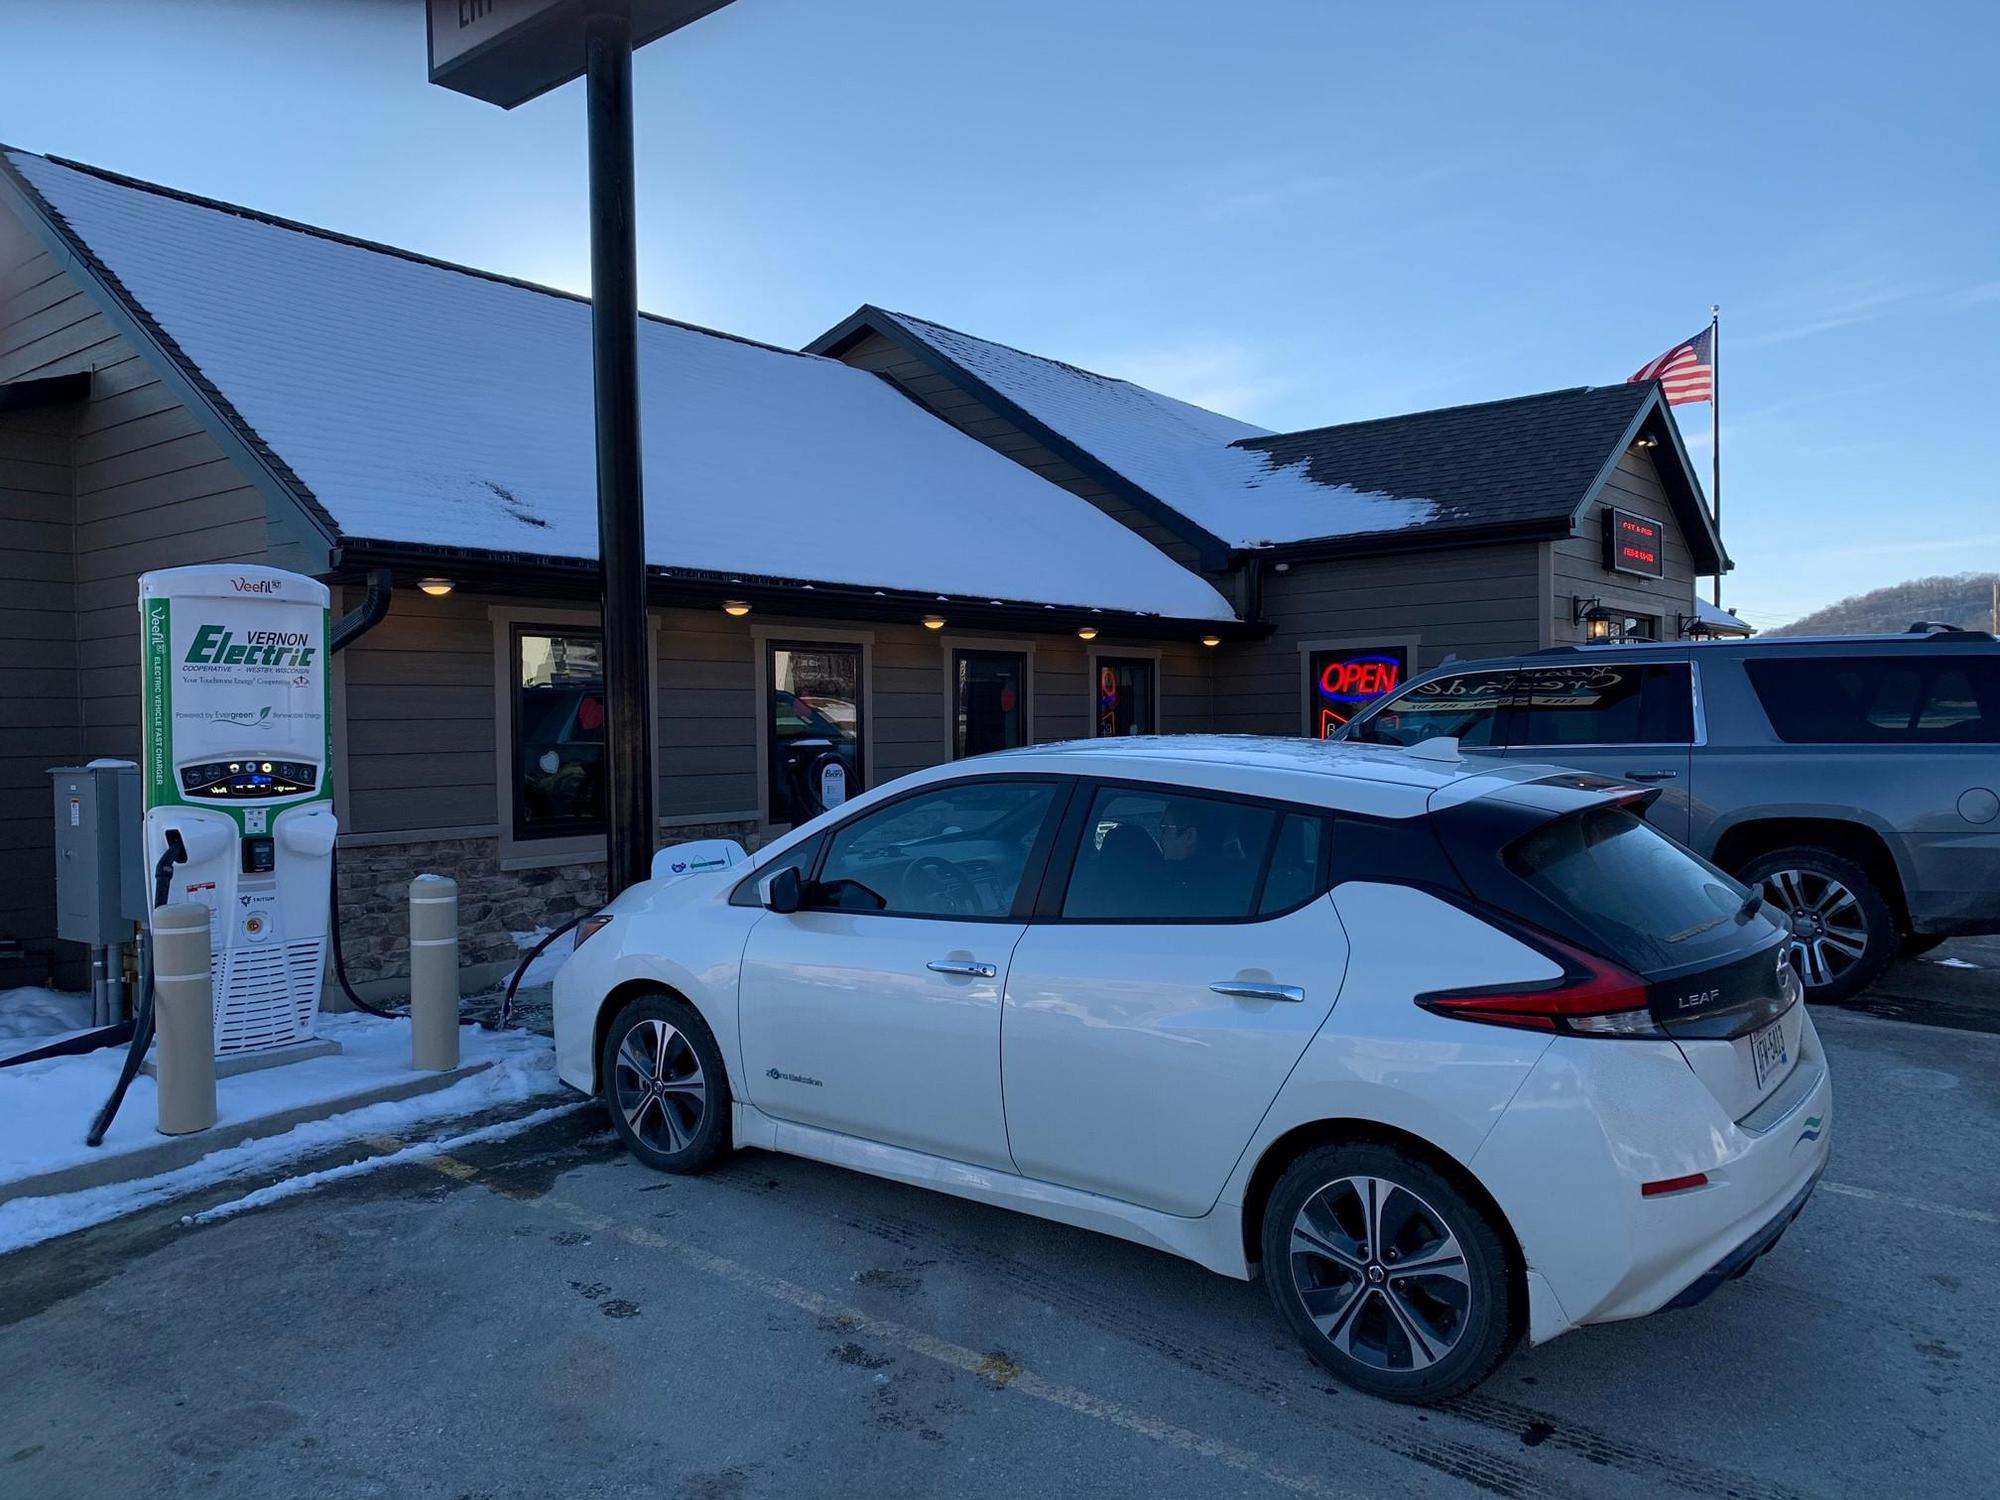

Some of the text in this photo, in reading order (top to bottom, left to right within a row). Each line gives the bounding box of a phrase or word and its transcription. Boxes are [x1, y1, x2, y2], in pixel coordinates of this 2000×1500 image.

[230, 577, 272, 593] Veefil
[151, 607, 166, 645] Veefil
[247, 631, 308, 646] VERNON
[184, 624, 316, 667] Electric
[154, 656, 162, 693] ELECTRIC
[182, 665, 233, 673] COOPERATIVE
[1321, 662, 1398, 694] OPEN
[154, 694, 162, 726] VEHICLE
[154, 728, 162, 747] FAST
[154, 750, 162, 785] CHARGER
[1679, 989, 1719, 1008] LEAF
